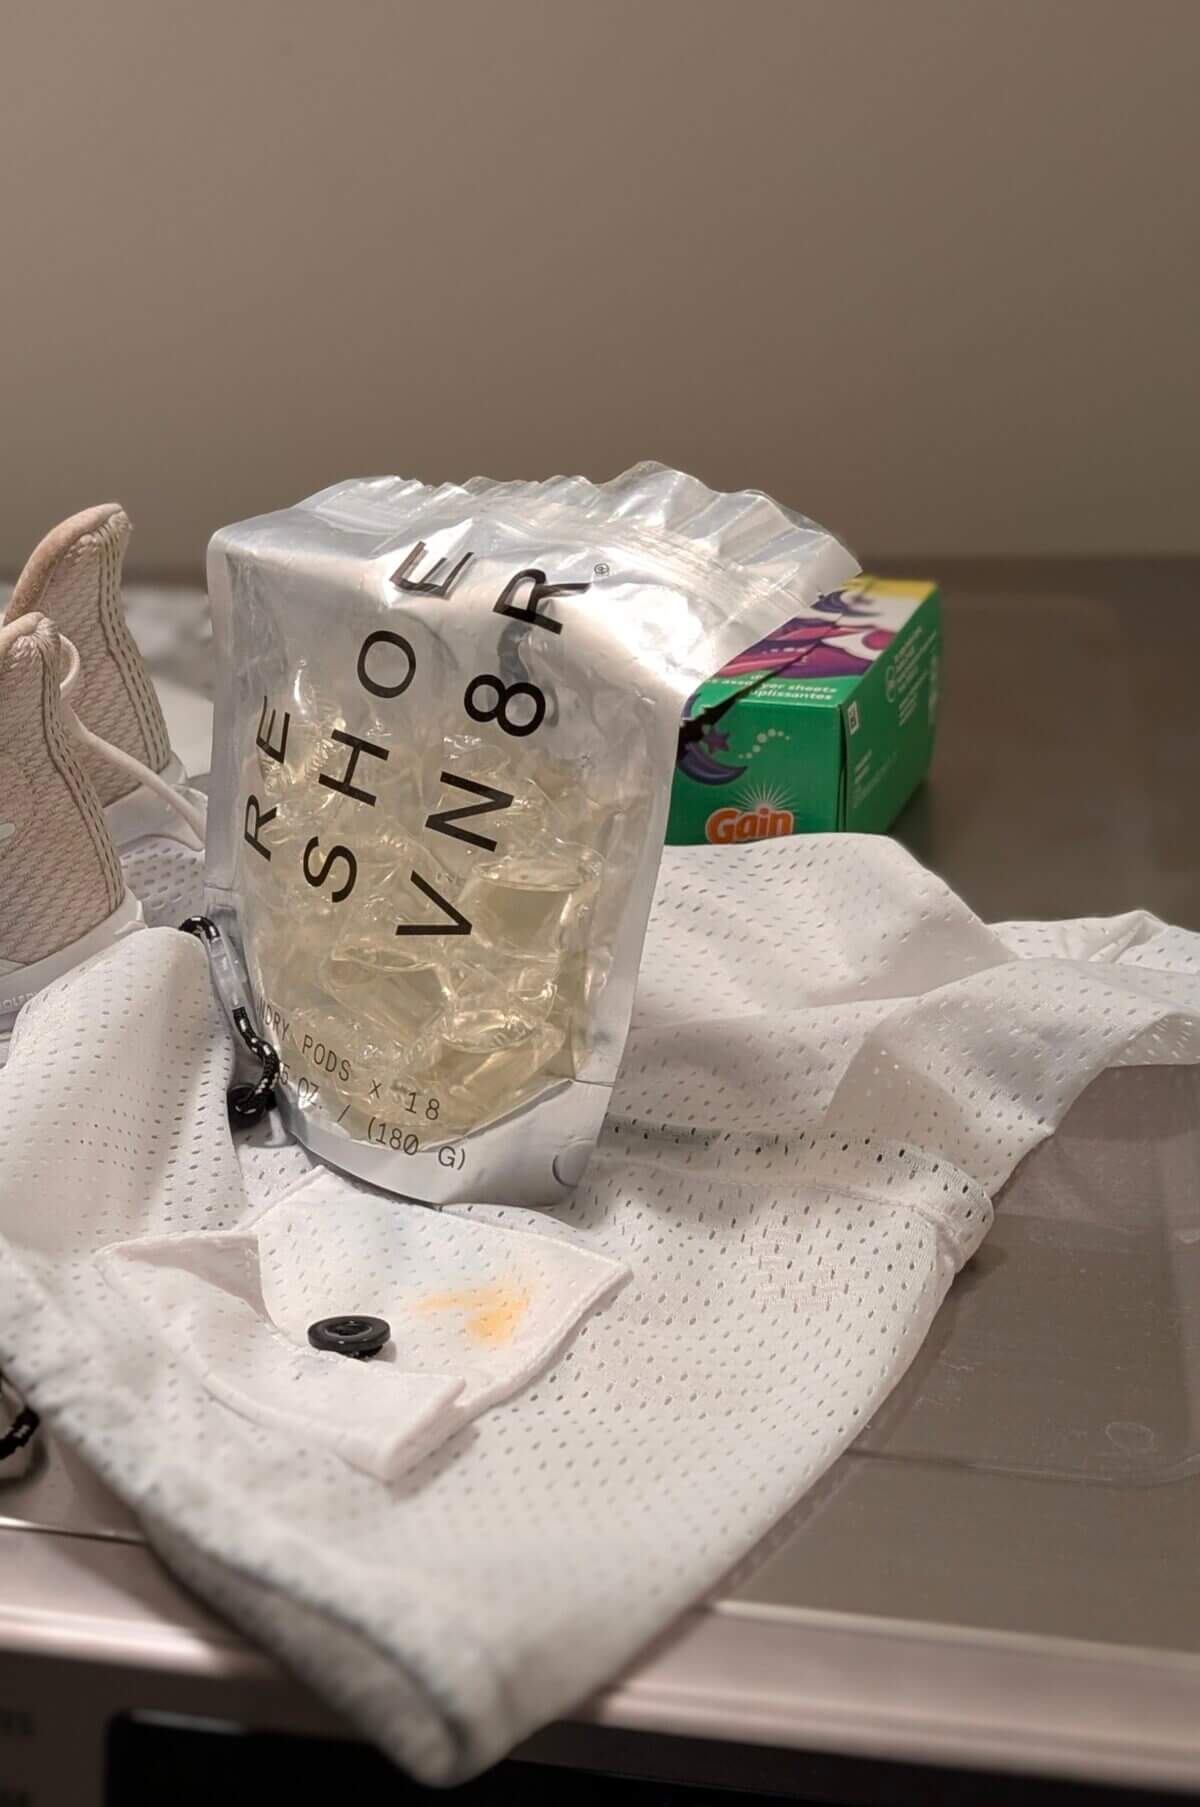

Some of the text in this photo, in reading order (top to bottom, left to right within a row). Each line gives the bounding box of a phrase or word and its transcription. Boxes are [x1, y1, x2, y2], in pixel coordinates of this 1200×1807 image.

[303, 540, 474, 903] SHOE
[788, 683, 837, 693] sheets
[244, 695, 290, 860] RE
[706, 806, 793, 843] Gain
[302, 1035, 351, 1081] PODS
[405, 1092, 441, 1121] 18
[368, 1116, 420, 1156] (180
[438, 1146, 466, 1171] G)
